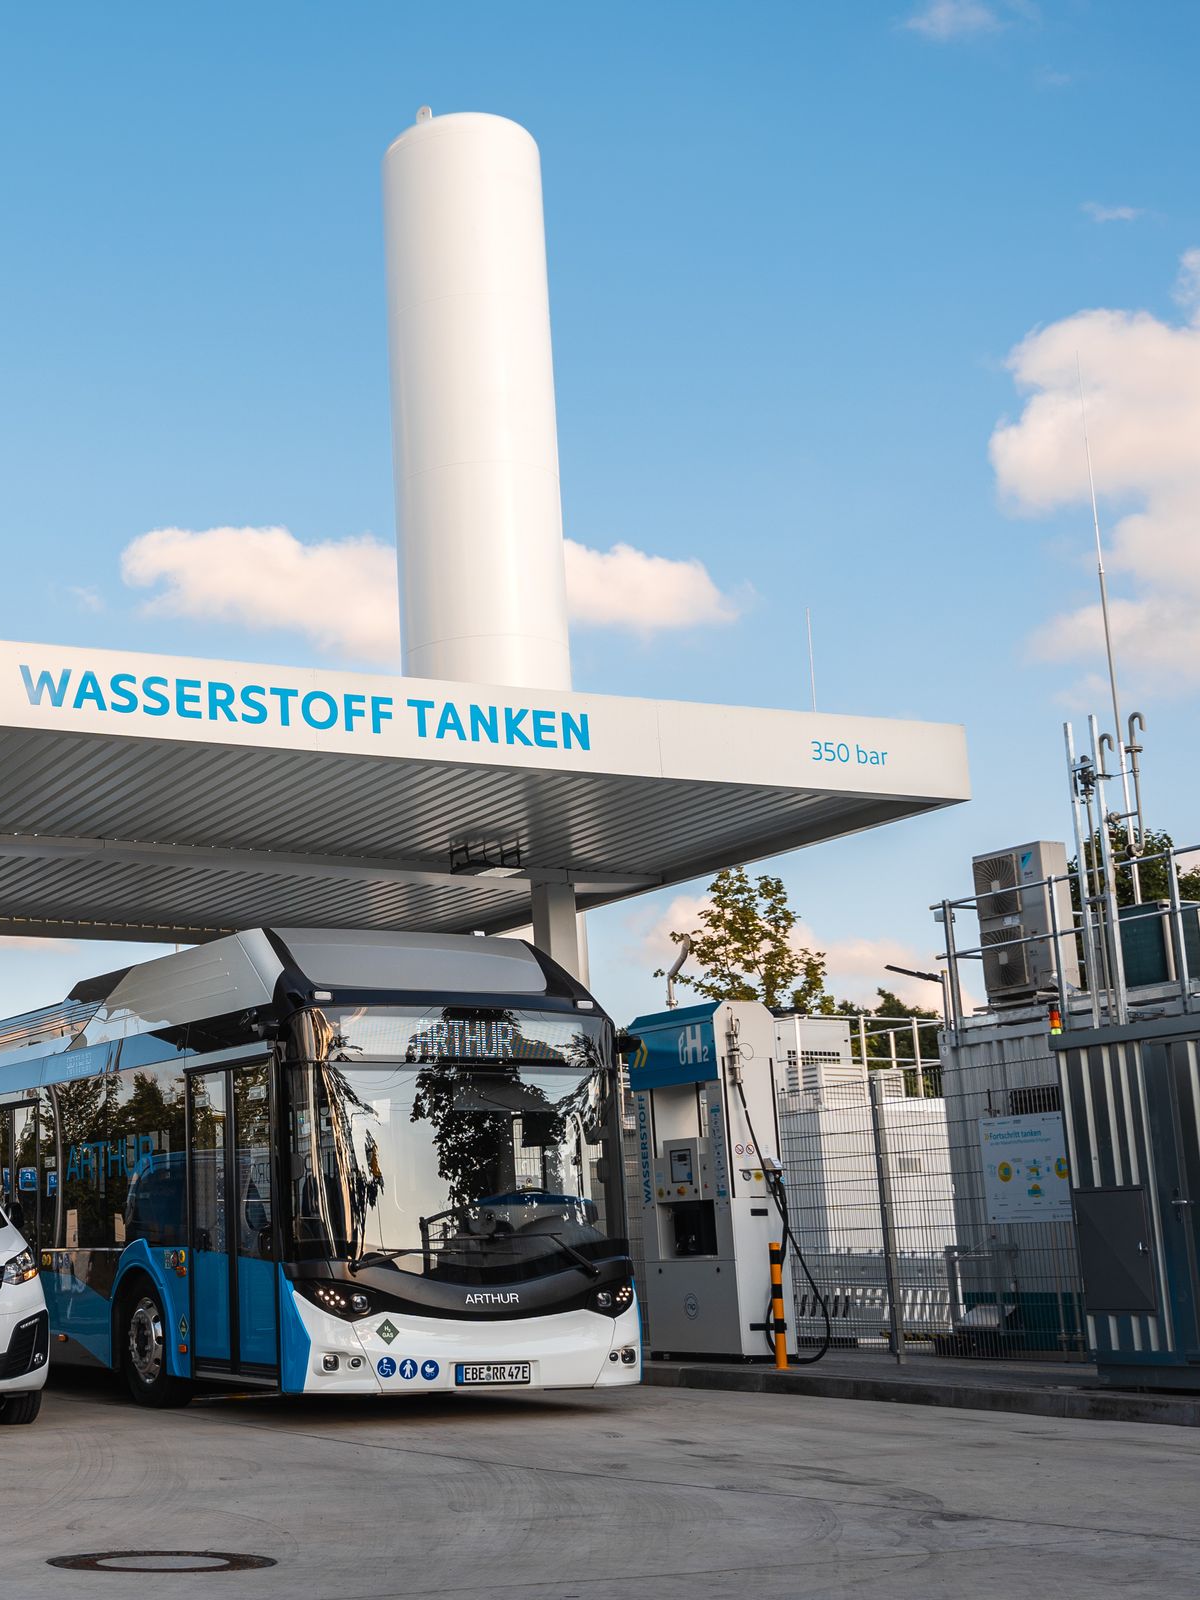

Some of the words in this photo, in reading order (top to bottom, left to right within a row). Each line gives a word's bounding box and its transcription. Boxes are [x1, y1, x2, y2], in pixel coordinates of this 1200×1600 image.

[18, 663, 394, 734] WASSERSTOFF
[406, 697, 592, 751] TANKEN
[810, 740, 850, 763] 350
[856, 743, 888, 766] bar
[416, 1019, 514, 1058] ARTHUR
[637, 1095, 652, 1204] WASSERSTOFF
[1020, 1129, 1042, 1138] tanken
[66, 1135, 155, 1182] ARTHUR
[465, 1293, 520, 1305] ARTHUR
[464, 1366, 485, 1381] EBE
[492, 1366, 506, 1380] RR
